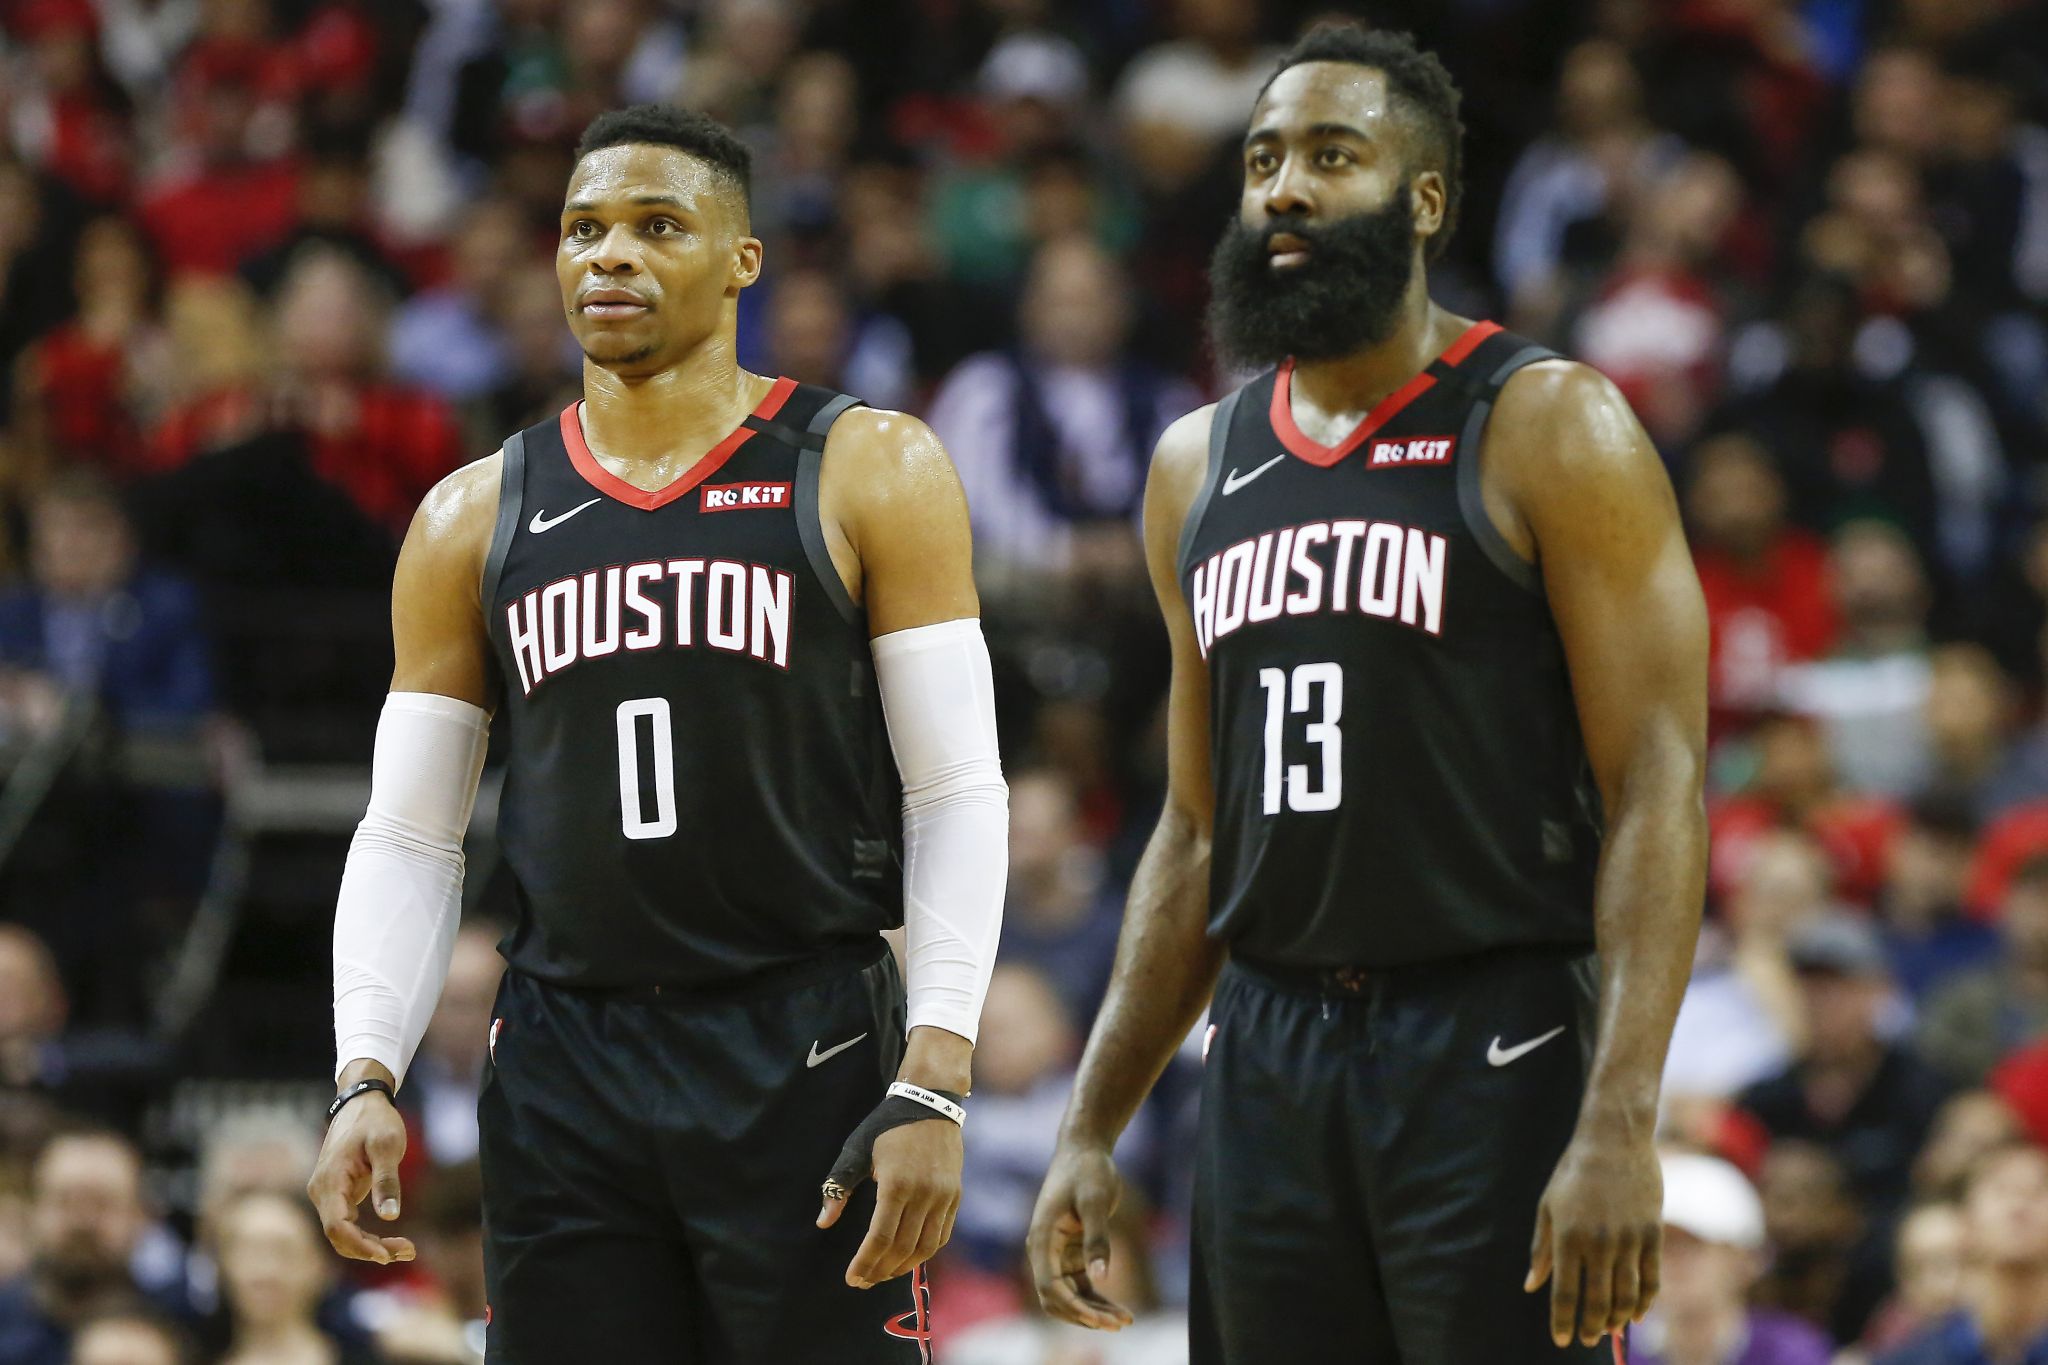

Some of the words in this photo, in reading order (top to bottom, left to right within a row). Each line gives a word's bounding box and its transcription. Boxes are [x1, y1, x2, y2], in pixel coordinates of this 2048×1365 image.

[506, 558, 793, 697] HOUSTON
[1192, 519, 1448, 660] HOUSTON
[616, 697, 678, 840] 0
[1259, 661, 1344, 816] 13
[920, 1094, 935, 1103] WHY
